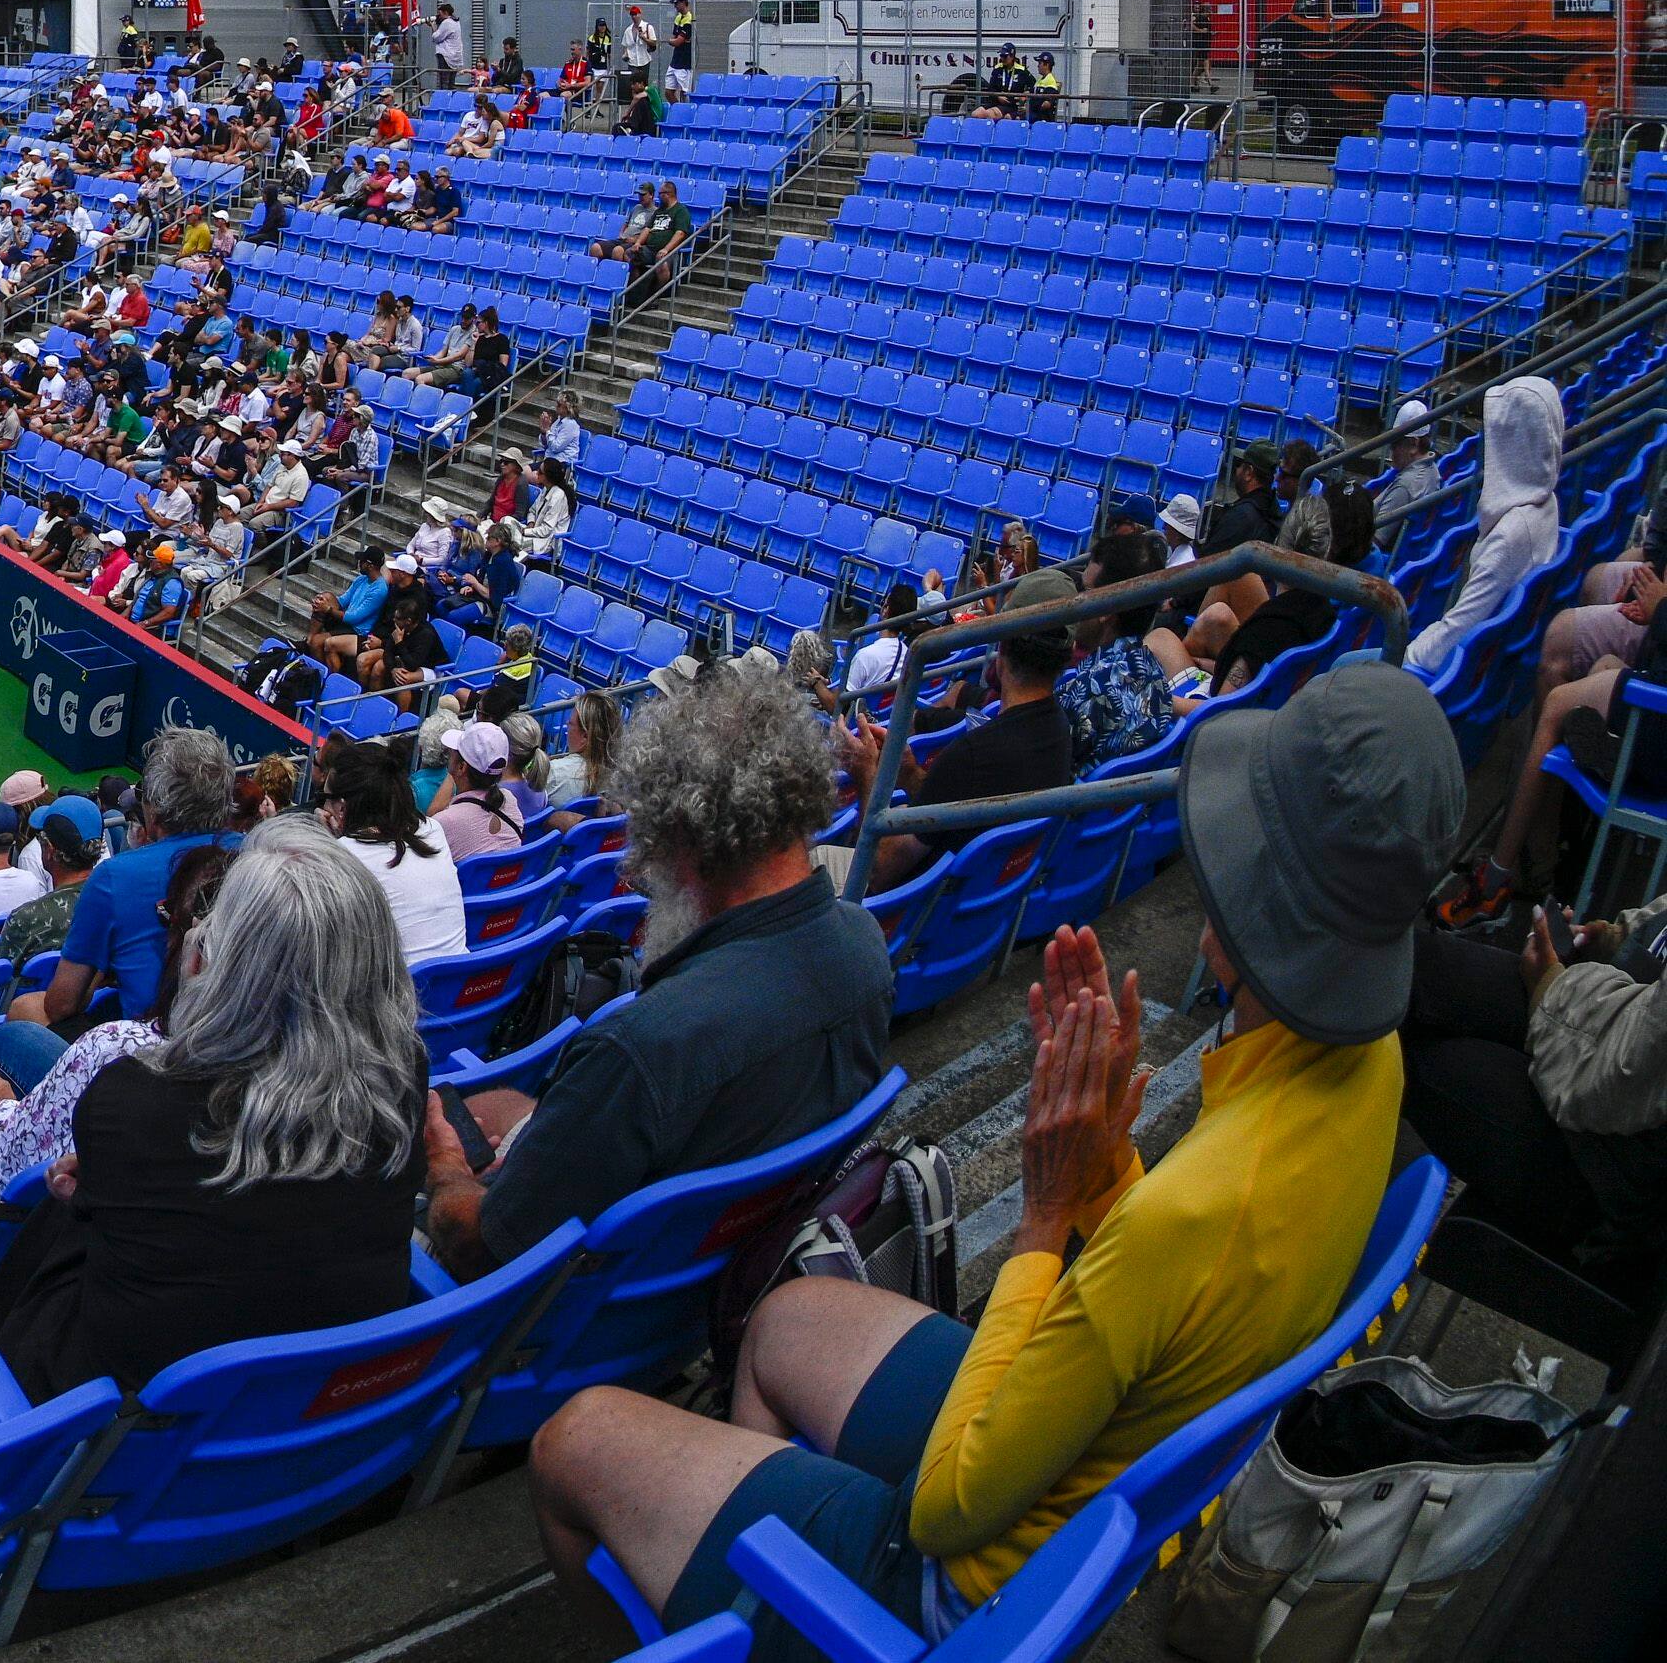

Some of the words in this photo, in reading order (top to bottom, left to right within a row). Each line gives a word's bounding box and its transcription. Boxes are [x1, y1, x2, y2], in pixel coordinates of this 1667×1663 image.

[931, 5, 975, 19] Provence
[993, 4, 1019, 20] 1870
[870, 50, 941, 68] Churros
[946, 51, 957, 68] &
[33, 672, 53, 716] G
[58, 690, 80, 735] G
[89, 693, 125, 738] G
[473, 977, 502, 993] ROGERS
[347, 1352, 422, 1399] ROGERS
